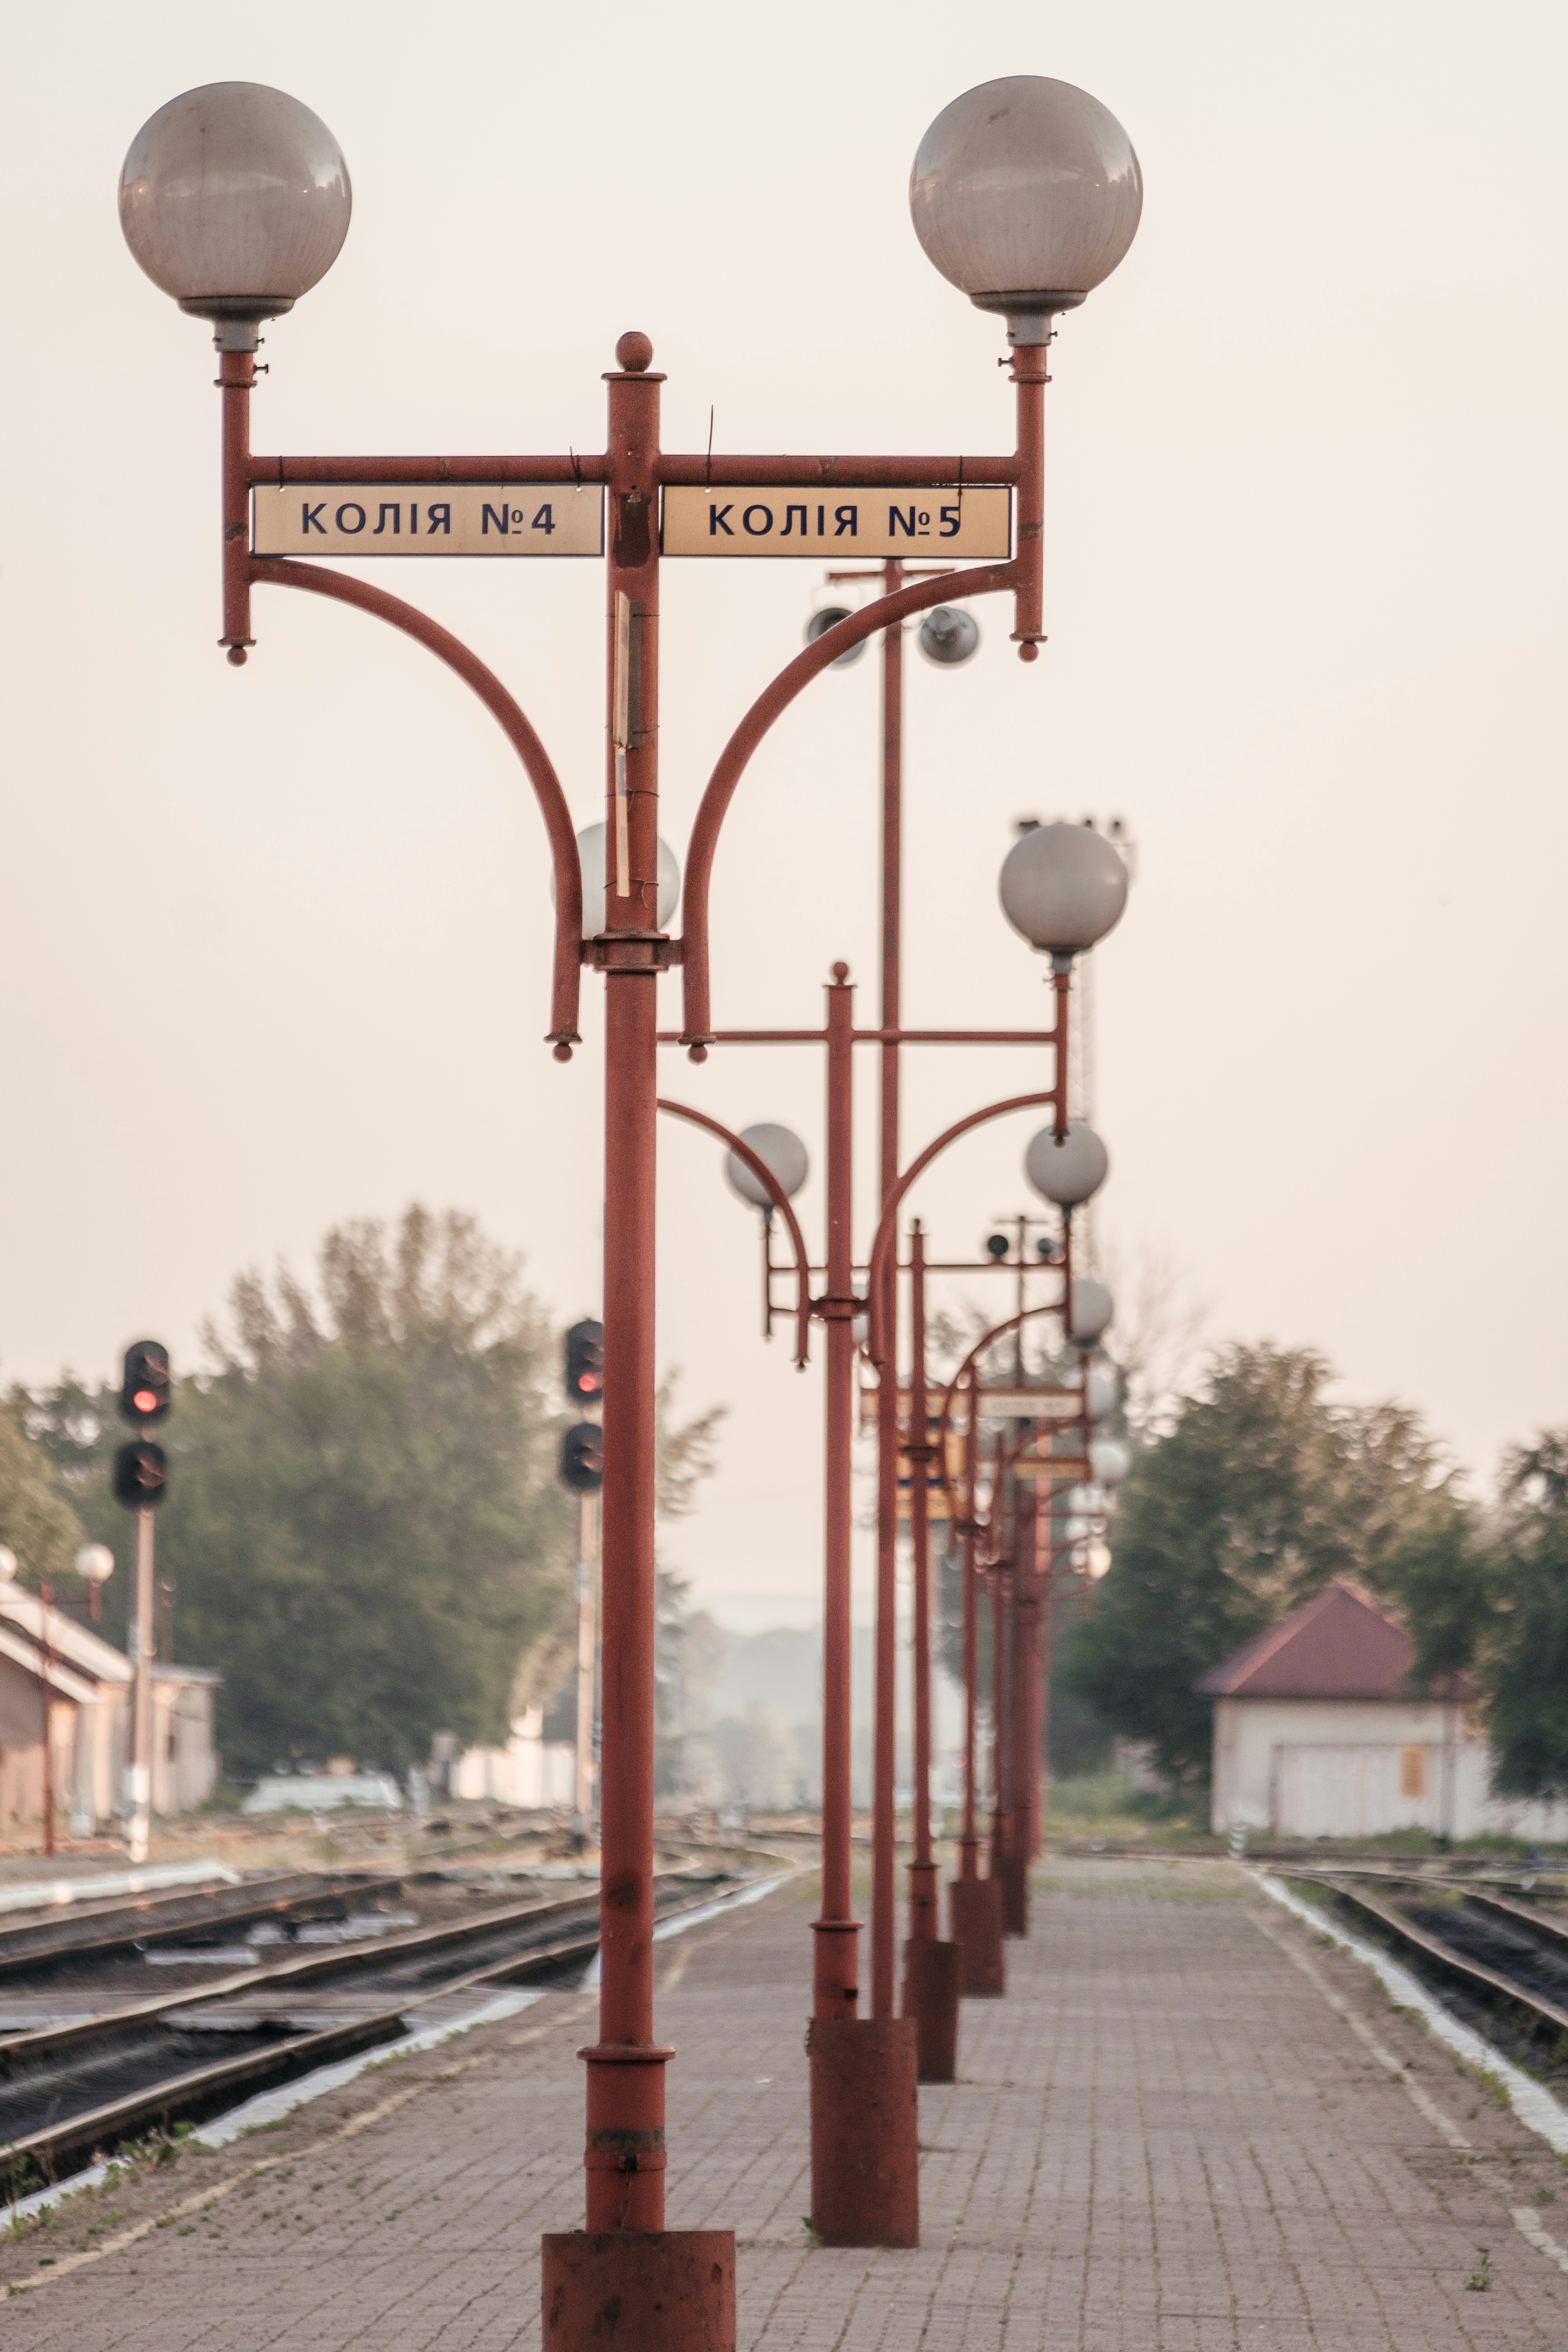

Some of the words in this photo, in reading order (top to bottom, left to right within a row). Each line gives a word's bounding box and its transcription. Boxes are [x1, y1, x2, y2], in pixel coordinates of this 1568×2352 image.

[302, 503, 451, 535] КОЛІЯ
[481, 503, 556, 535] №4
[709, 504, 858, 537] КОЛІЯ
[889, 505, 961, 538] №5
